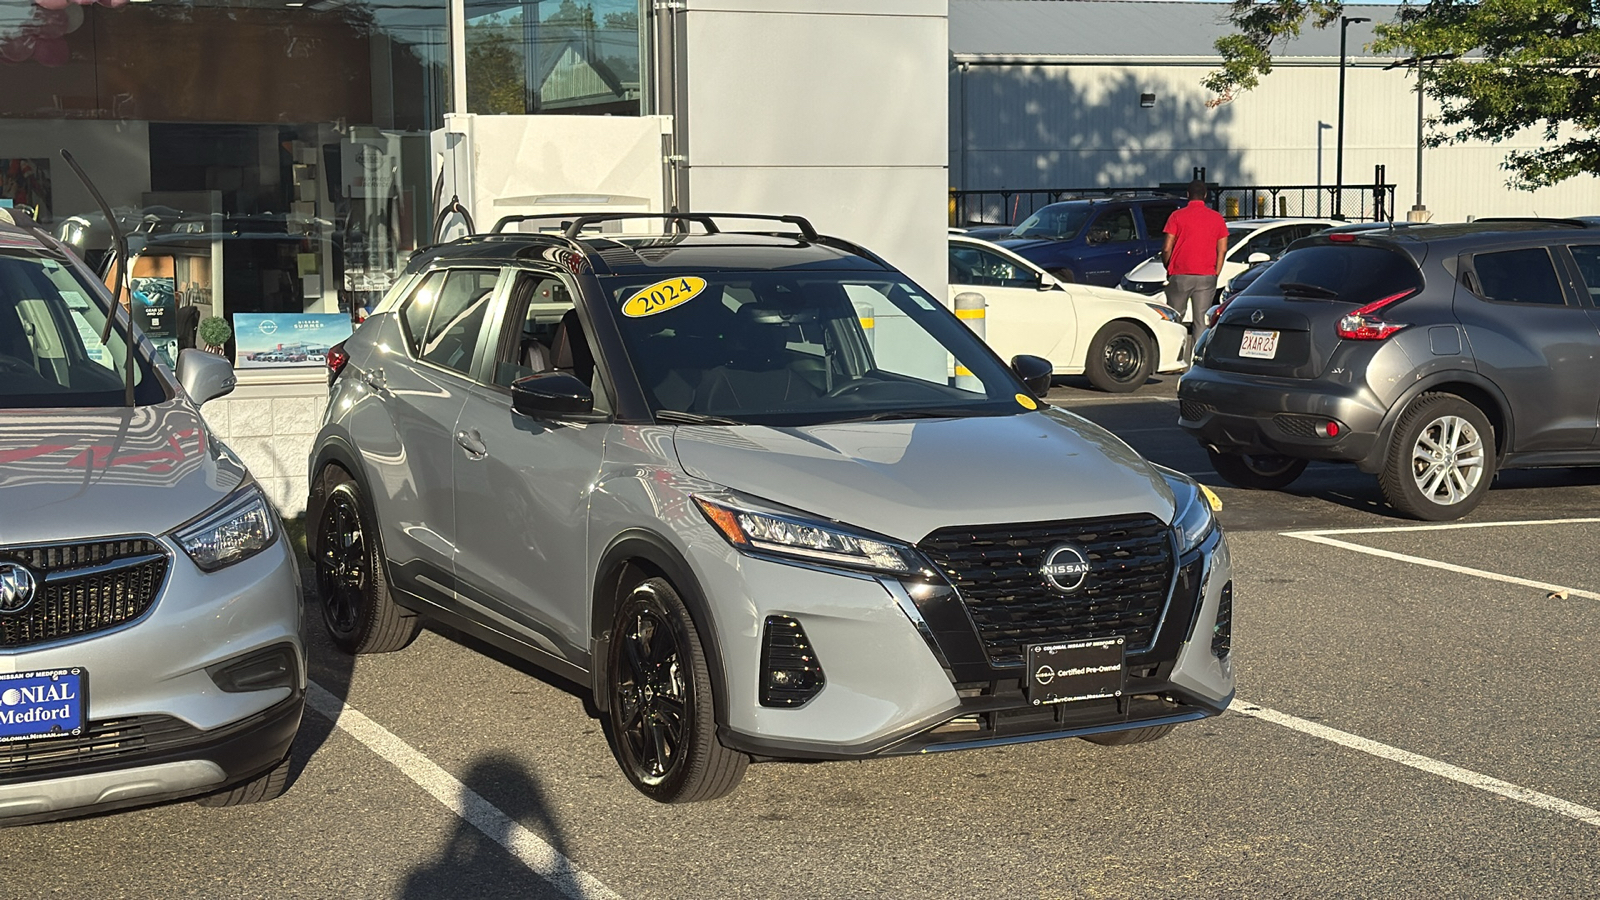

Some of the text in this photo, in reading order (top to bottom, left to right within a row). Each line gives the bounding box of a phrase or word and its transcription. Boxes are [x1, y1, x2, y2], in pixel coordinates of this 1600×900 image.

[637, 278, 692, 313] 2024
[1242, 336, 1263, 350] 2XAR
[1044, 564, 1089, 575] NISSAN
[1057, 663, 1121, 676] Certified Pre-Owned
[0, 683, 75, 706] ONIAL
[0, 704, 70, 724] Medford
